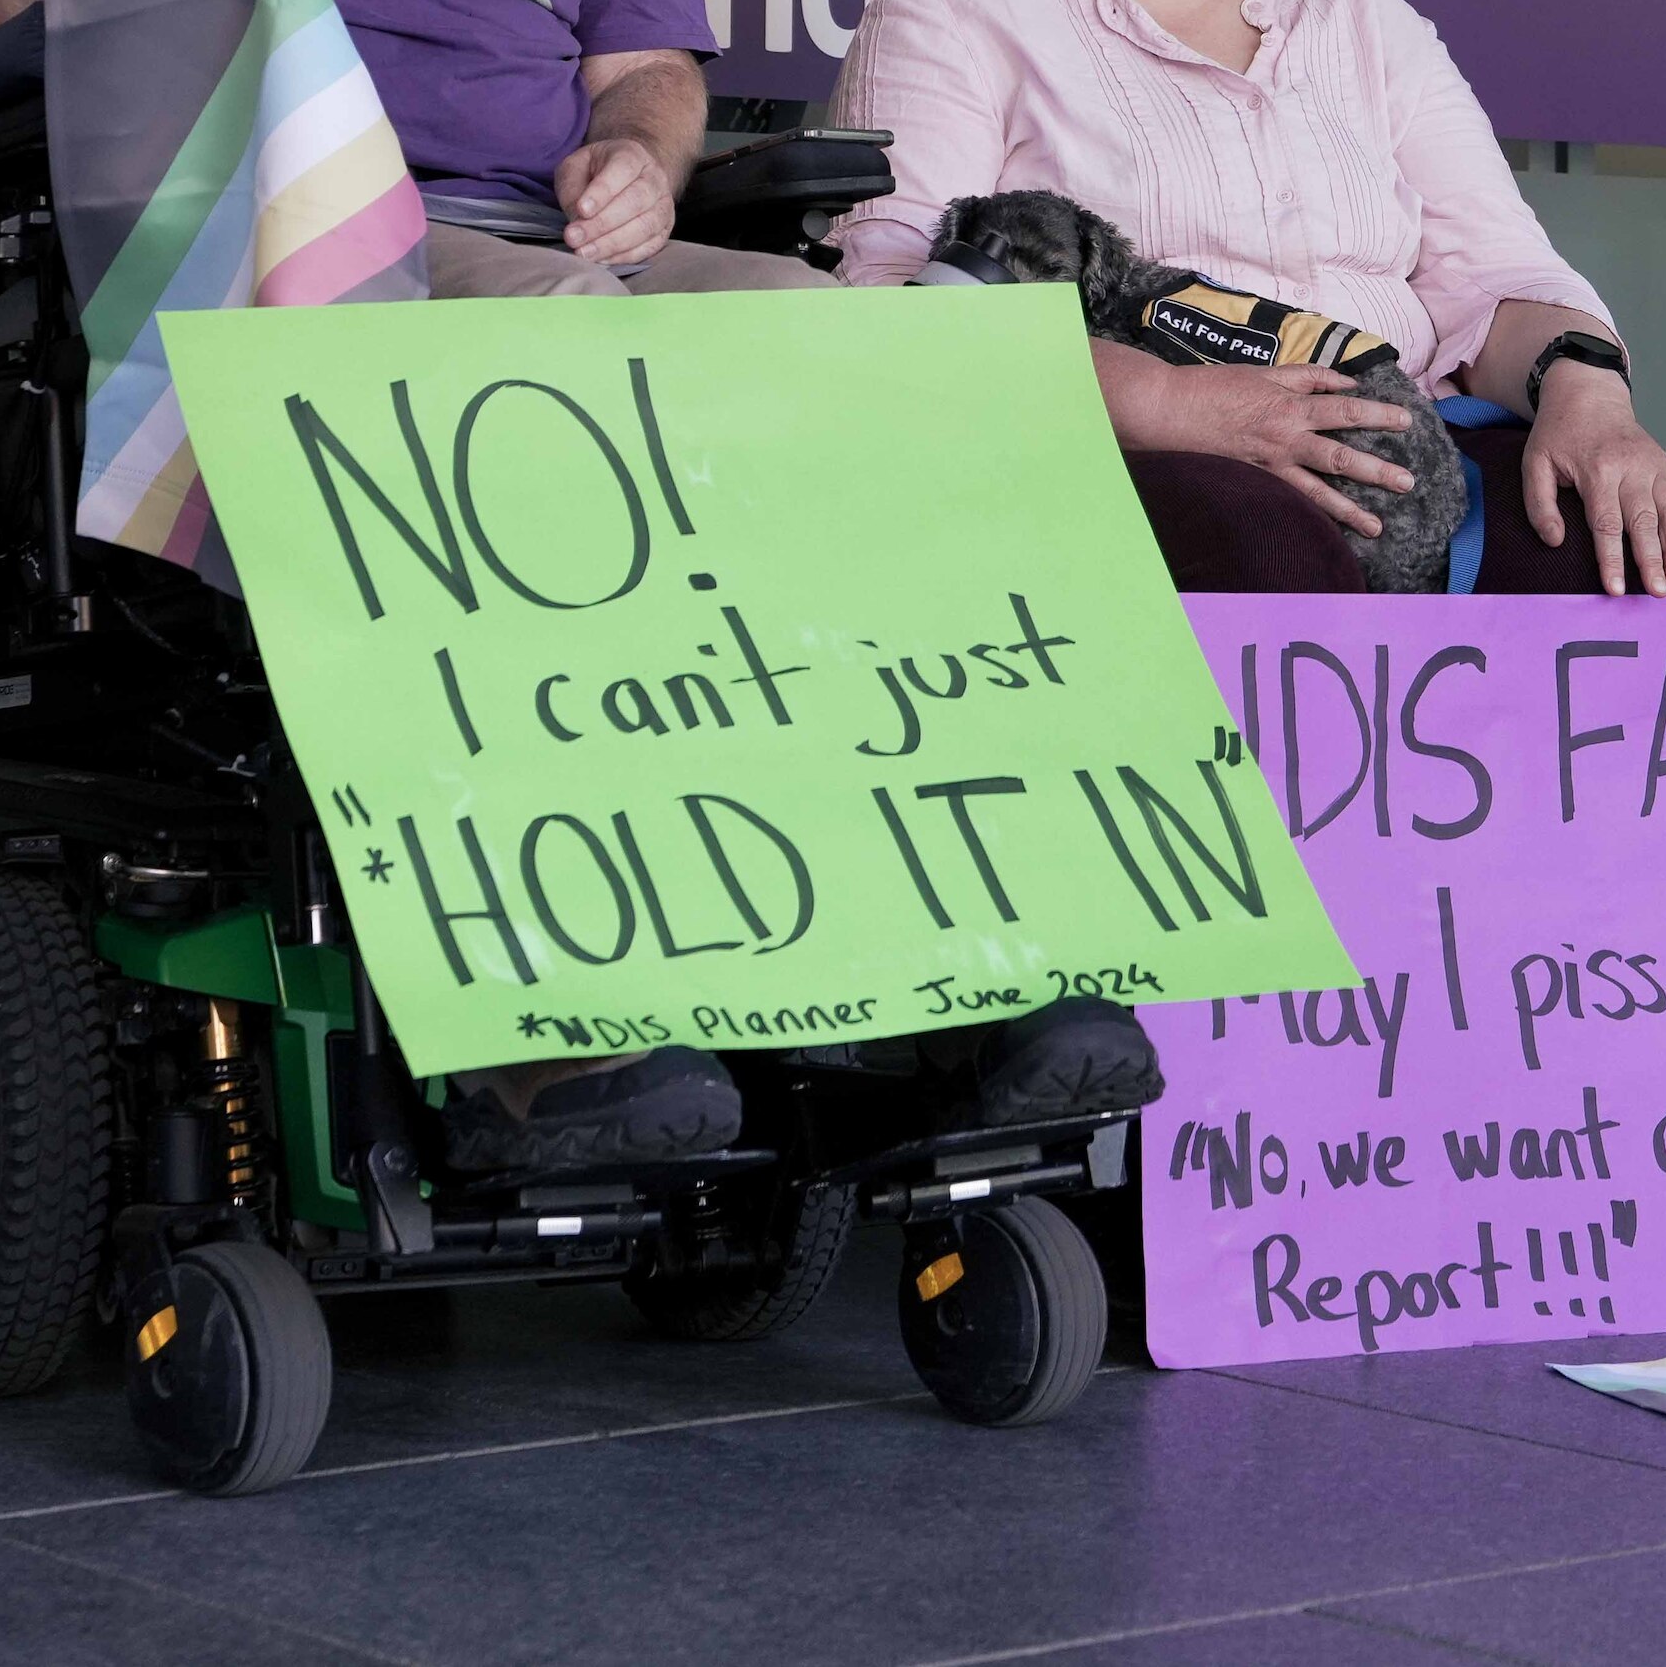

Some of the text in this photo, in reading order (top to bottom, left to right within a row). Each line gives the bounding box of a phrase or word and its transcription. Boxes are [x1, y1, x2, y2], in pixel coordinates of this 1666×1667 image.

[1158, 310, 1271, 360] Ask For Pats
[283, 357, 719, 622] NO!
[438, 591, 1077, 757] I can't just
[870, 775, 1027, 931] IT
[693, 998, 877, 1037] Planner
[914, 977, 1031, 1015] June
[1046, 964, 1164, 1001] 2024
[1437, 887, 1469, 1031] I
[1317, 1121, 1414, 1188] we
[1443, 1086, 1620, 1182] want
